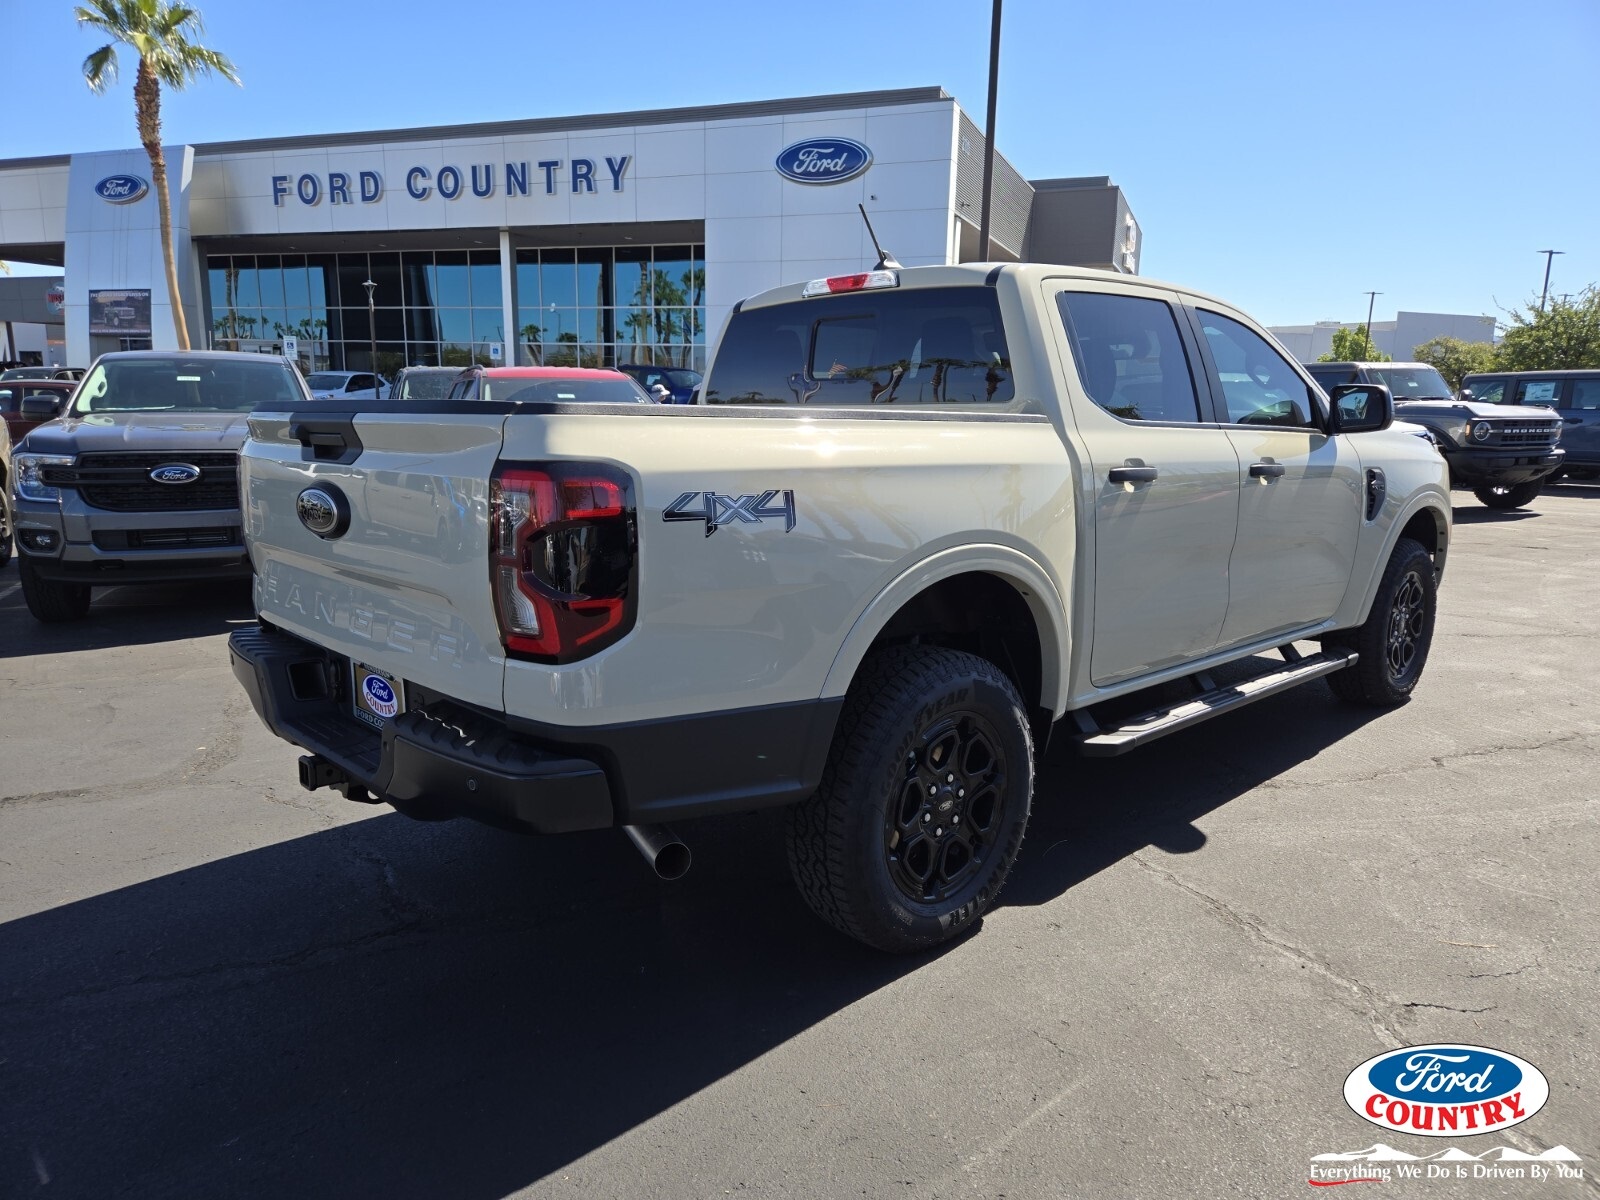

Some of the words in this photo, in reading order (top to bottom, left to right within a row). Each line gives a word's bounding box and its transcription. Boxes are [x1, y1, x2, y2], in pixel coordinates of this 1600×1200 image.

[793, 147, 848, 174] Ford
[103, 179, 131, 196] Ford
[271, 170, 382, 207] FORD
[405, 154, 631, 201] COUNTRY
[162, 470, 188, 480] Ford
[371, 679, 389, 700] Ford
[366, 692, 396, 715] COUNTRY
[357, 710, 374, 723] FORD
